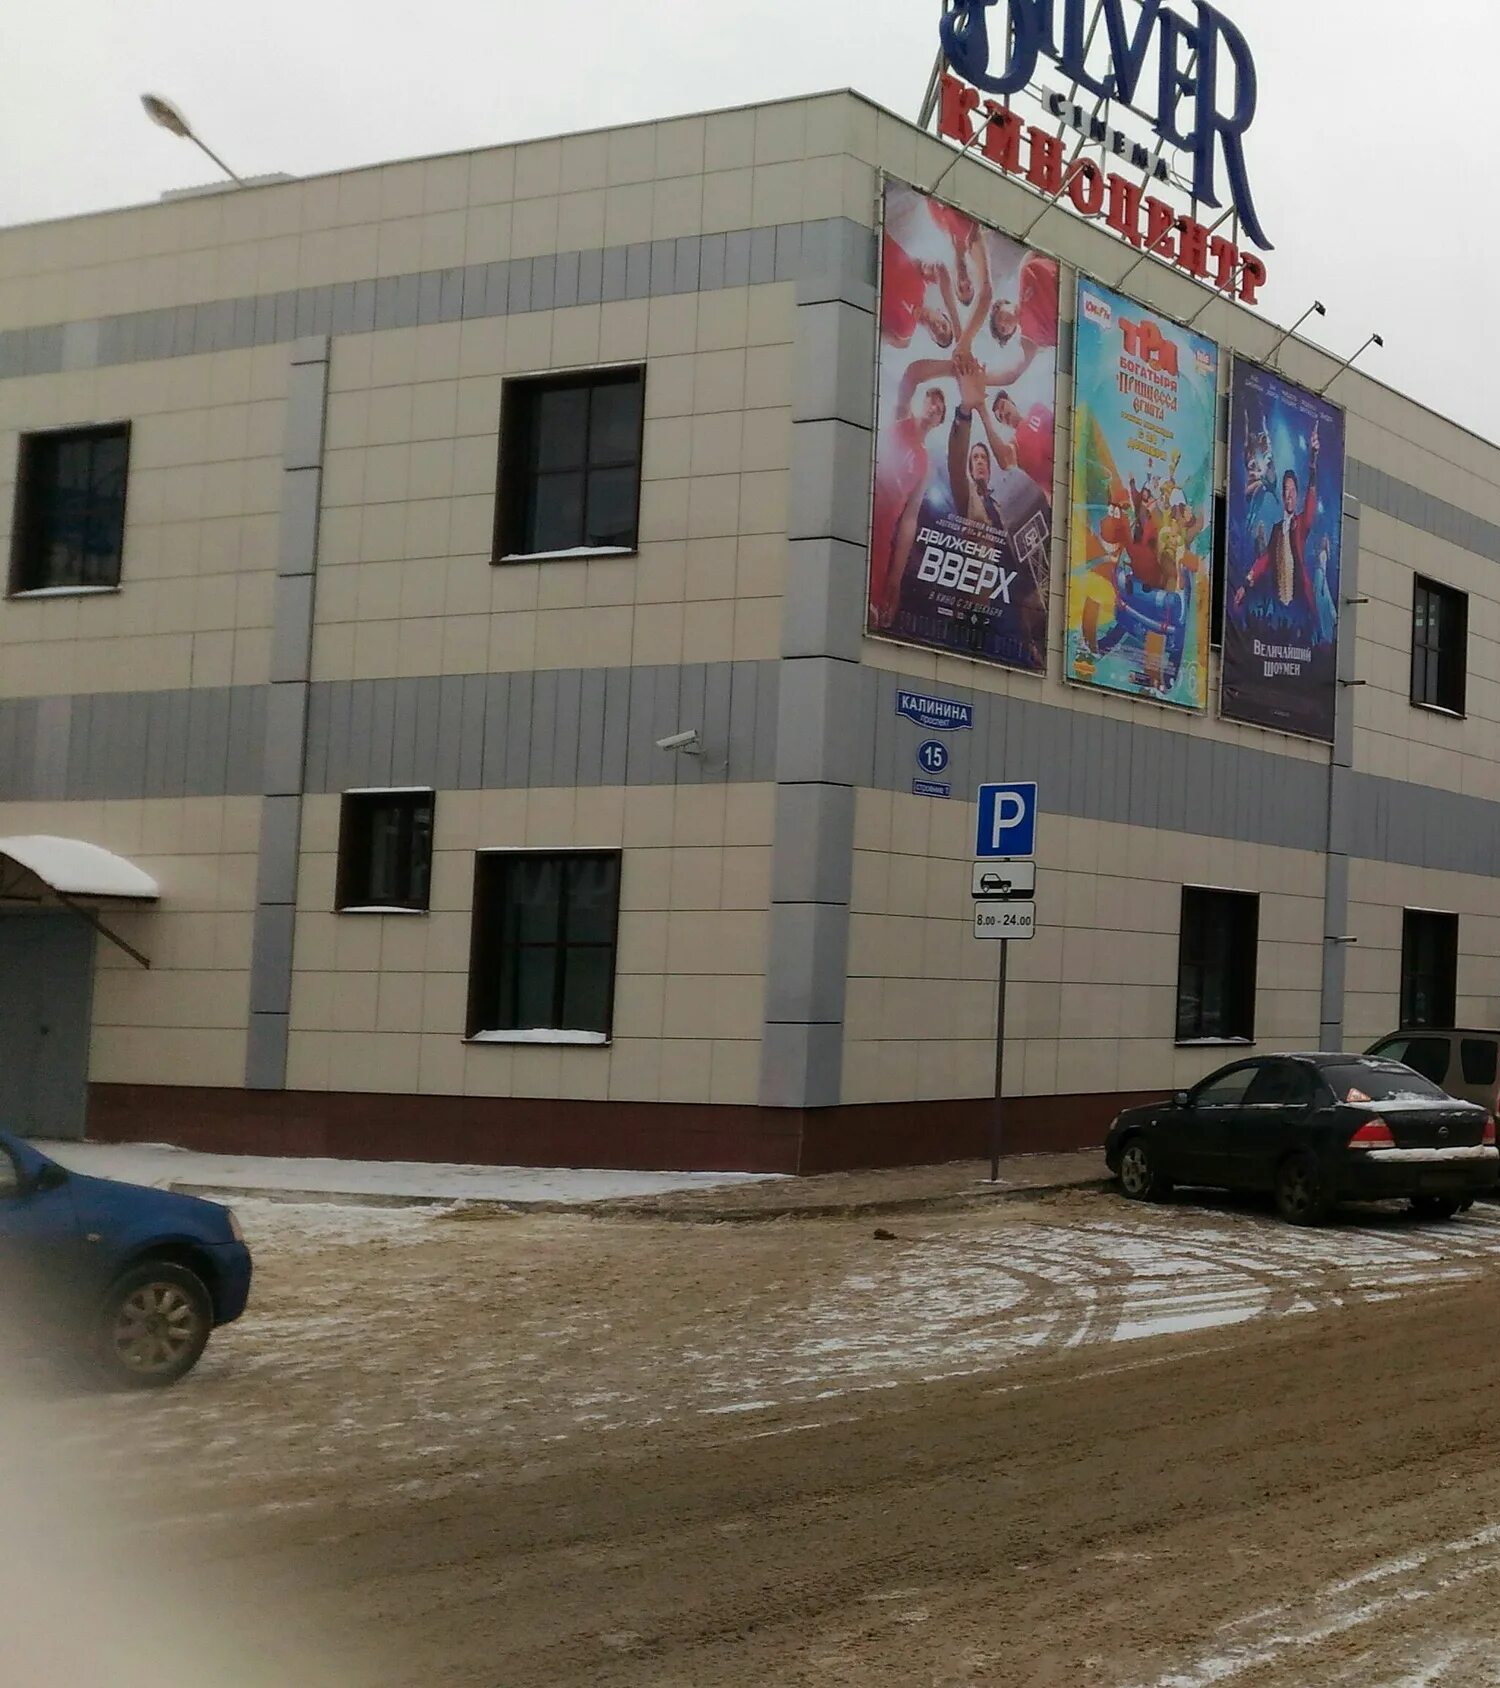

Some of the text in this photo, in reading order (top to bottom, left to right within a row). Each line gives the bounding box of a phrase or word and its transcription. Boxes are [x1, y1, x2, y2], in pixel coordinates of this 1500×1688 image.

[1048, 92, 1170, 183] CINEMA
[939, 71, 1268, 305] КИНОЦЕНТР
[1120, 356, 1178, 393] БОГАТЫРЯ
[916, 527, 1003, 562] ДВИЖЕНИЕ
[917, 545, 1018, 604] ВВЕРХ
[901, 695, 968, 722] КАЛИНИНА
[920, 714, 951, 727] проспект
[924, 746, 942, 768] 15
[976, 914, 996, 926] 8.00
[1003, 914, 1032, 926] 24.00
